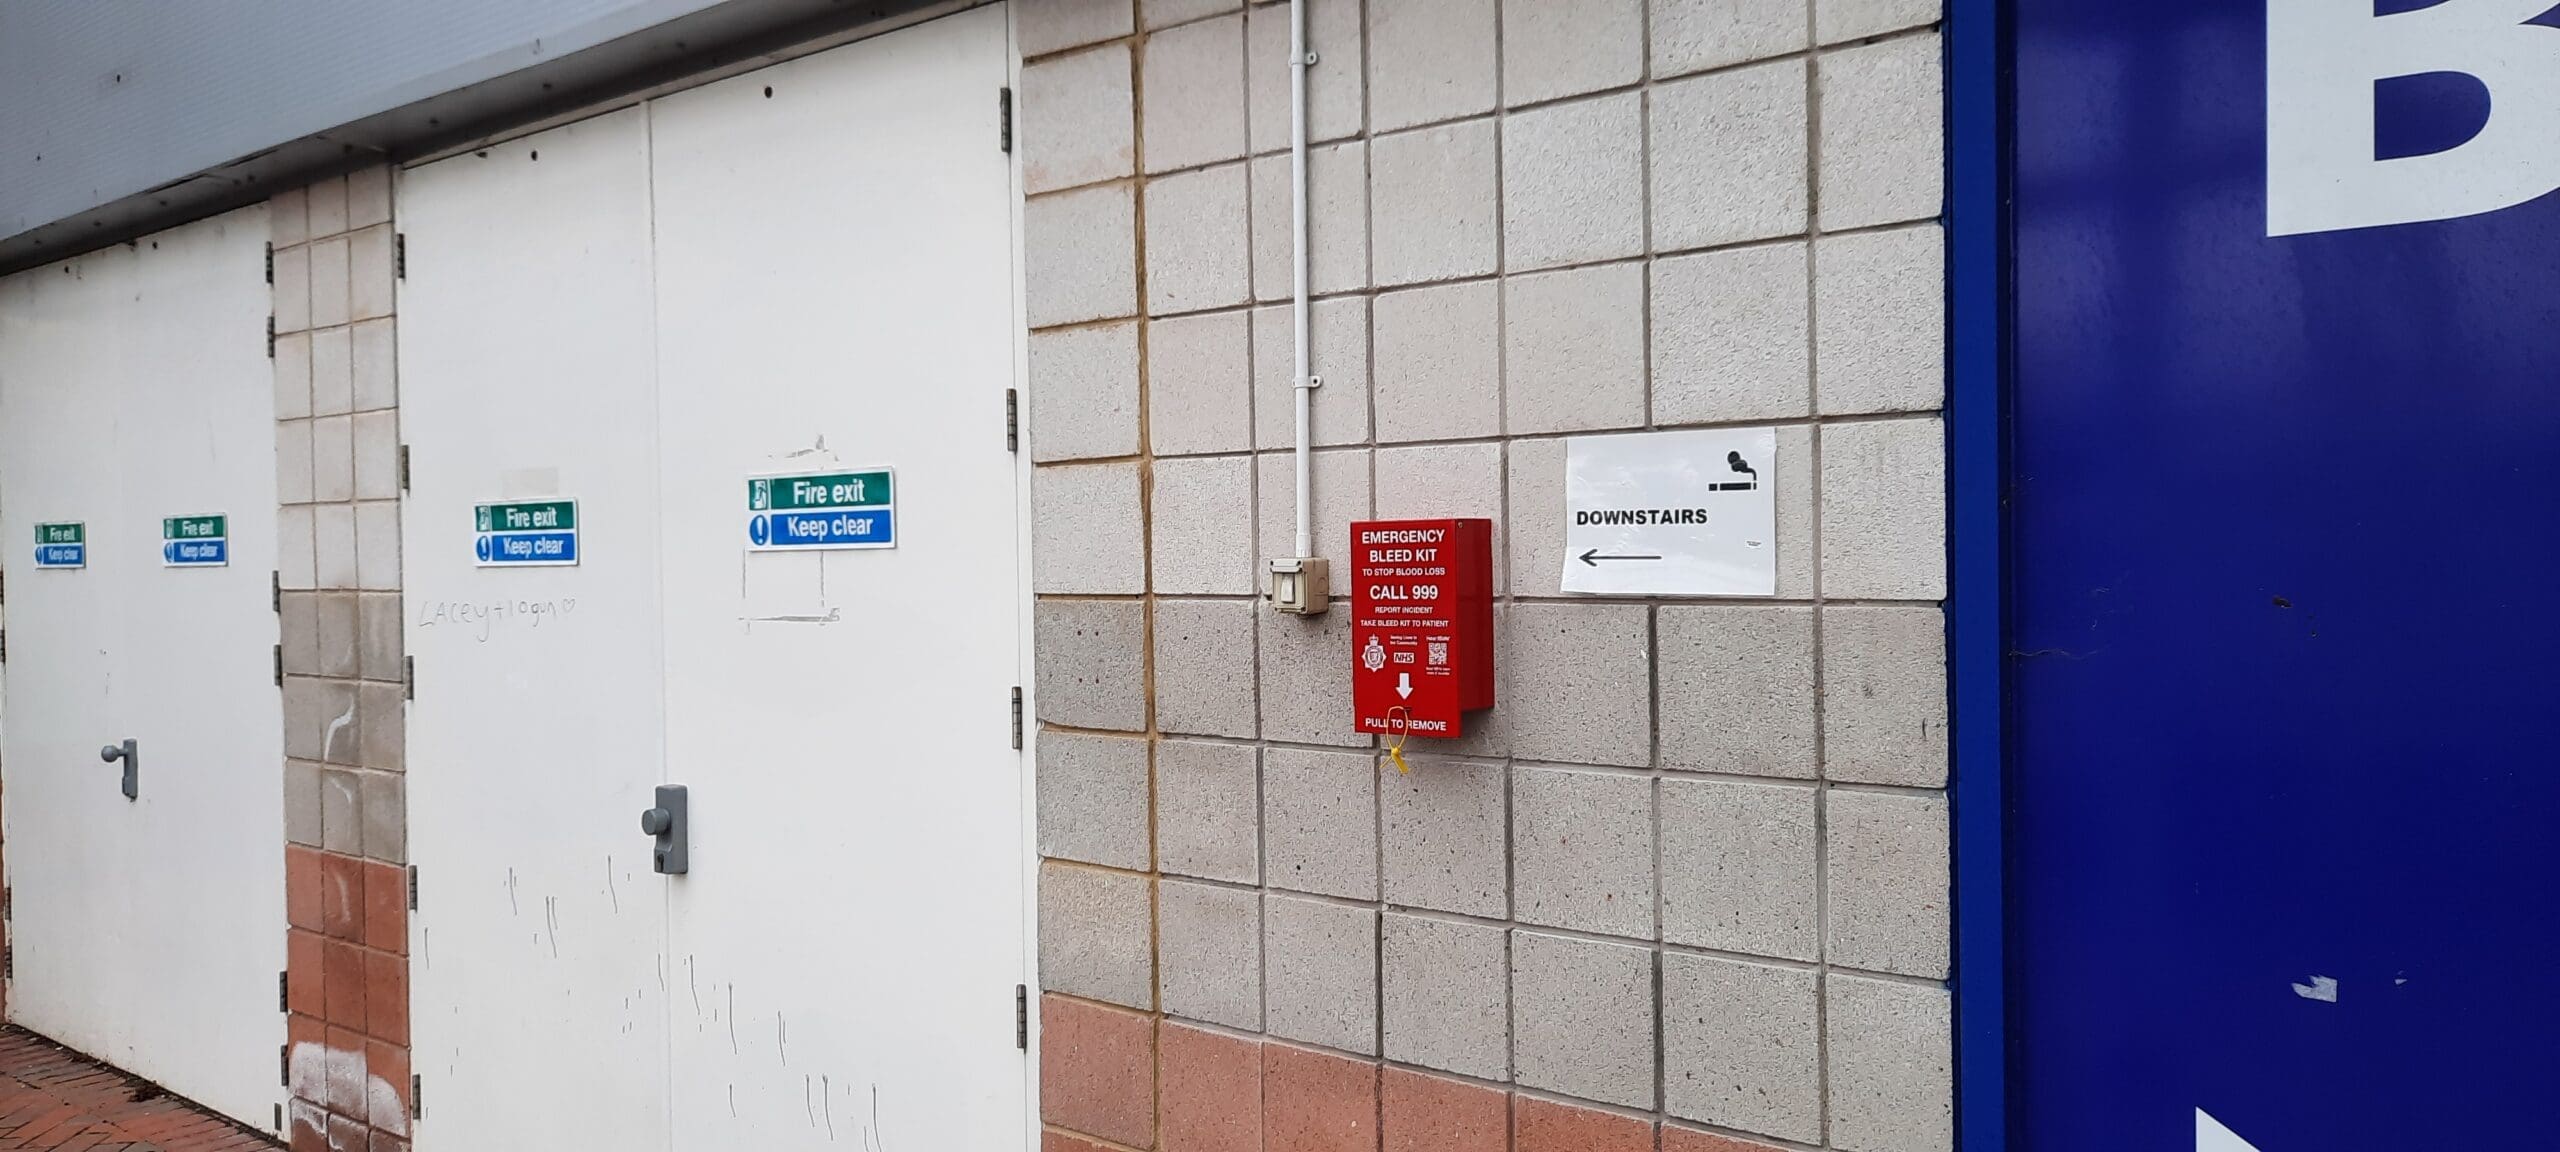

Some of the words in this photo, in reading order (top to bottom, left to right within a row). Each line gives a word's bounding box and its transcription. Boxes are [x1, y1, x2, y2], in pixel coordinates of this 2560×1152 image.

[793, 481, 827, 504] Fire
[832, 478, 865, 503] exit
[505, 508, 530, 528] Fire
[533, 505, 557, 527] exit
[1576, 508, 1708, 526] DOWNSTAIRS
[787, 516, 828, 541] Keep
[832, 514, 873, 536] clear
[1362, 529, 1445, 544] EMERGENCY
[503, 537, 532, 559] Keep
[534, 535, 564, 555] clear
[1369, 549, 1413, 562] BLEED
[1415, 548, 1438, 562] KIT
[1362, 568, 1373, 576] TO
[1374, 567, 1395, 576] STOP
[1396, 567, 1423, 576] BLOOD
[1424, 567, 1446, 576] LOSS
[1369, 585, 1409, 600] CALL
[1412, 585, 1439, 600] 999
[1375, 606, 1401, 614] REPORT
[1402, 606, 1433, 614] INCIDENT
[1360, 620, 1376, 628] TAKE
[1377, 620, 1399, 628] BLEED
[1400, 619, 1410, 628] KIT
[1412, 620, 1421, 628] TO
[1422, 620, 1449, 628] PATIENT
[1394, 653, 1414, 662] NHS
[1365, 717, 1388, 728] PULL
[1391, 718, 1404, 729] TO
